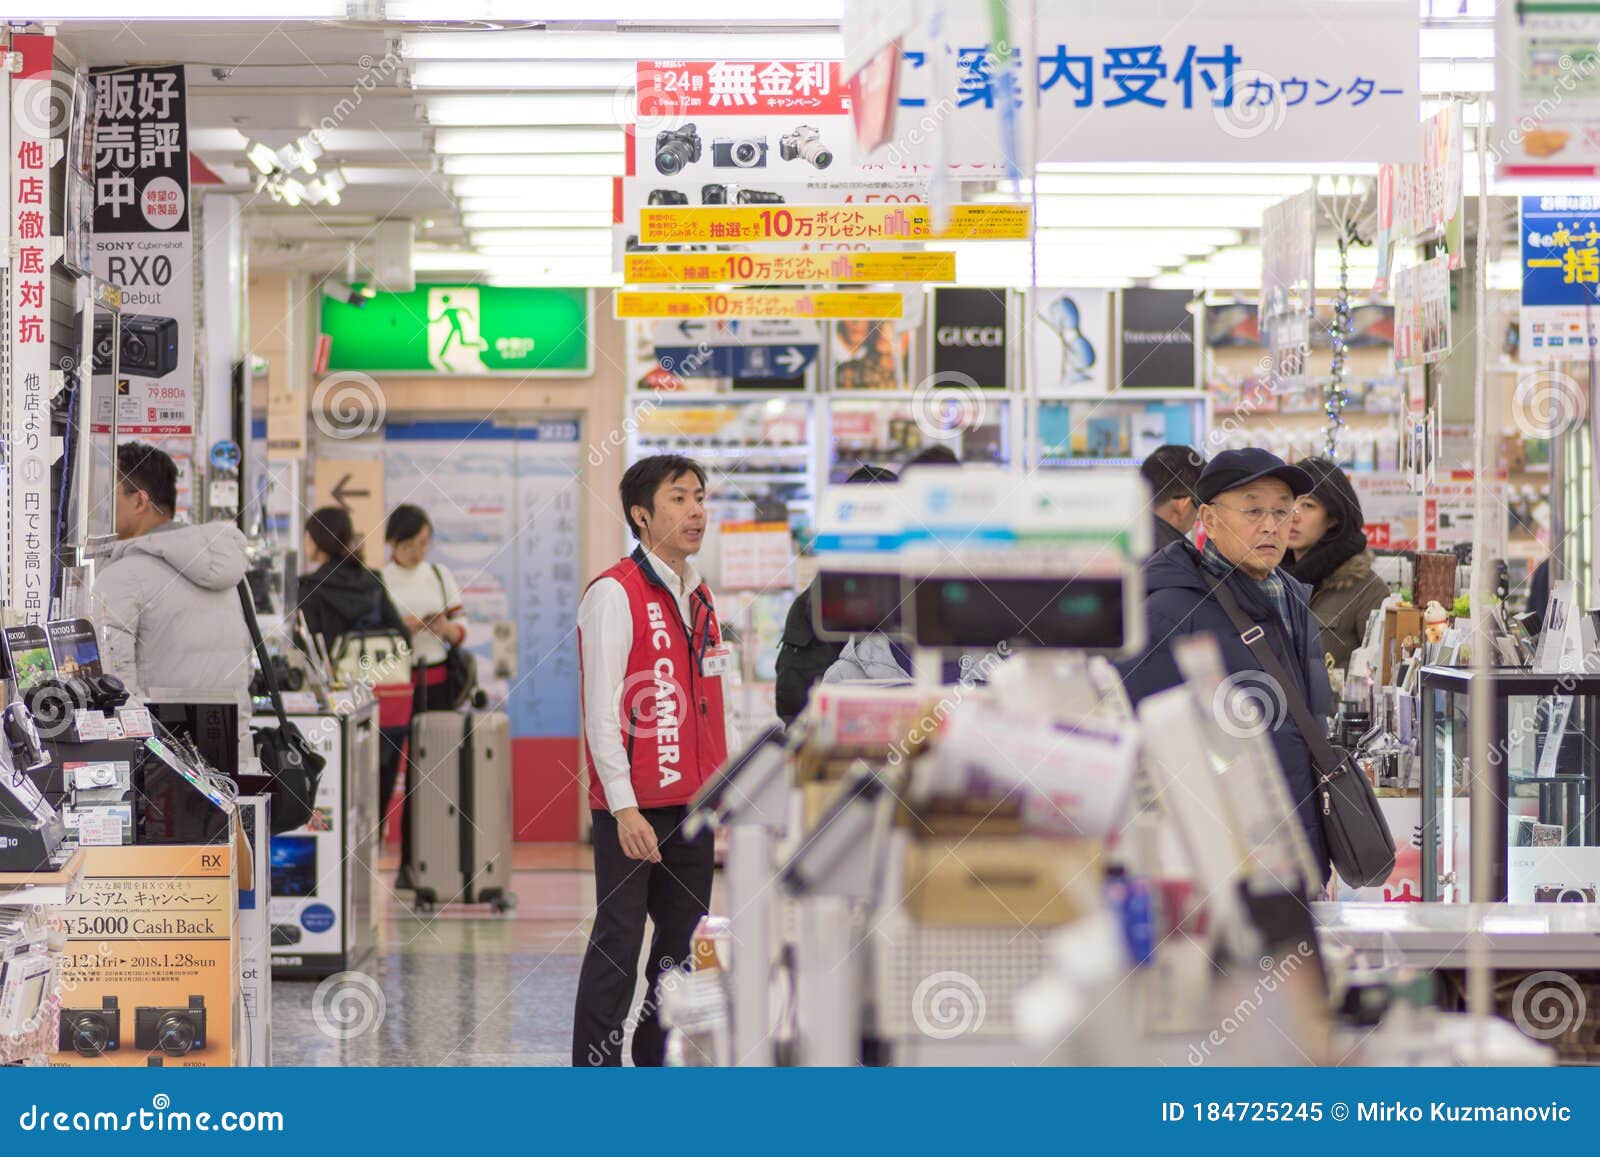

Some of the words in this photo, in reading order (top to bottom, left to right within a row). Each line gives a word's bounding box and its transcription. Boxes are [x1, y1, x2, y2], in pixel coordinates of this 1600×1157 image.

[708, 61, 831, 107] 無金利
[1245, 77, 1405, 107] カウンター
[767, 98, 821, 107] キャンペーン
[138, 73, 181, 168] 好評
[95, 75, 136, 219] 販売中
[147, 191, 177, 202] 待望の
[147, 204, 178, 216] 新製品
[817, 211, 864, 223] ポイント
[759, 210, 814, 237] 10万
[17, 141, 45, 344] 他店徹底対抗
[96, 242, 135, 251] SONY
[108, 255, 172, 287] RX0
[1527, 247, 1599, 283] 一括
[121, 291, 161, 304] Debut
[937, 326, 1003, 347] GUCCI
[646, 602, 671, 650] BIC
[654, 657, 682, 788] CAMERA
[201, 855, 221, 866] RX
[134, 891, 218, 905] キャンペーン
[64, 917, 129, 935] ¥5,000
[133, 919, 174, 934] Cash
[177, 919, 215, 934] Back
[131, 954, 216, 968] 2018.1.28sun
